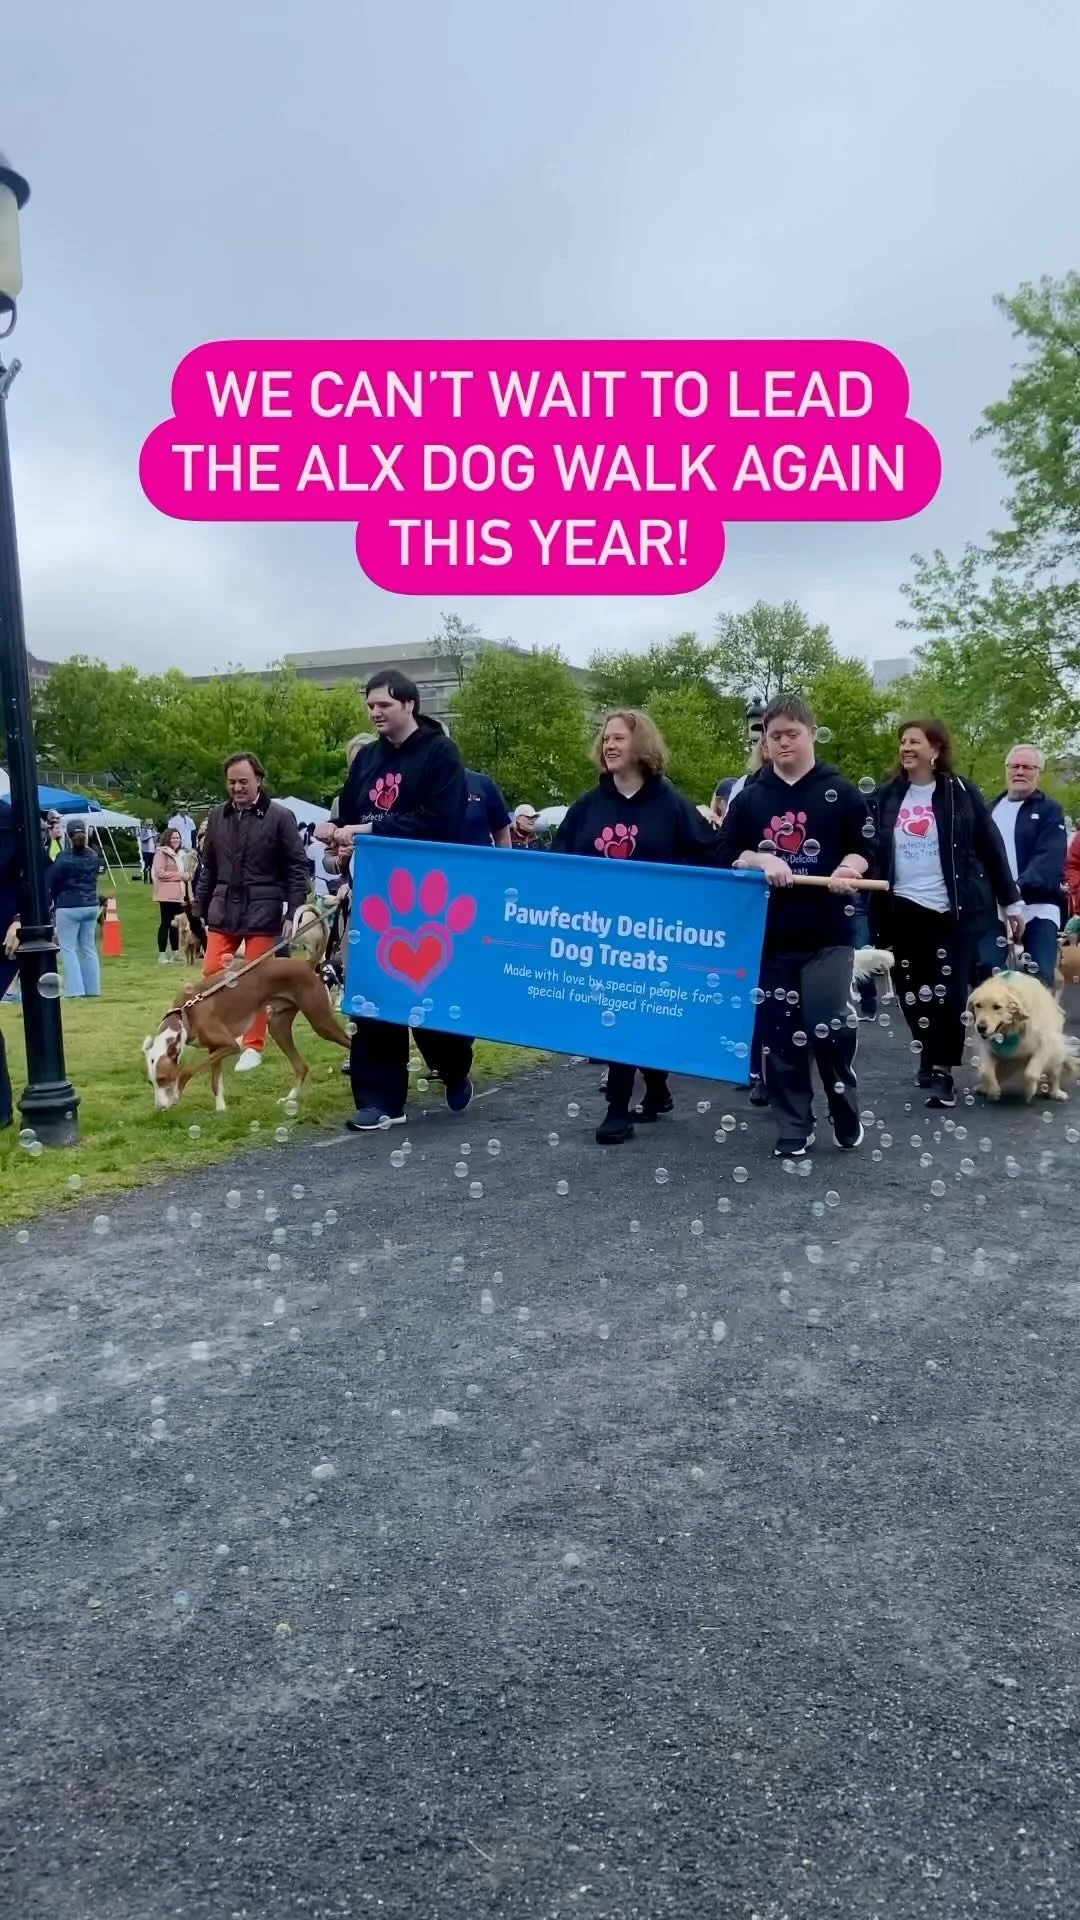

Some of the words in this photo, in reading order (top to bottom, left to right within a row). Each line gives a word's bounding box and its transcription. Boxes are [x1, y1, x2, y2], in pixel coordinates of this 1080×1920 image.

[504, 902, 612, 939] Pawfectly
[617, 915, 727, 949] Delicious
[550, 937, 594, 968] Dog
[599, 943, 669, 973] Treats
[503, 963, 532, 978] Made
[535, 968, 559, 982] with
[563, 970, 585, 986] love
[588, 974, 603, 991] by
[605, 980, 646, 994] special
[649, 986, 688, 1001] people
[691, 988, 713, 1005] for
[527, 985, 565, 999] special
[640, 999, 684, 1018] friends
